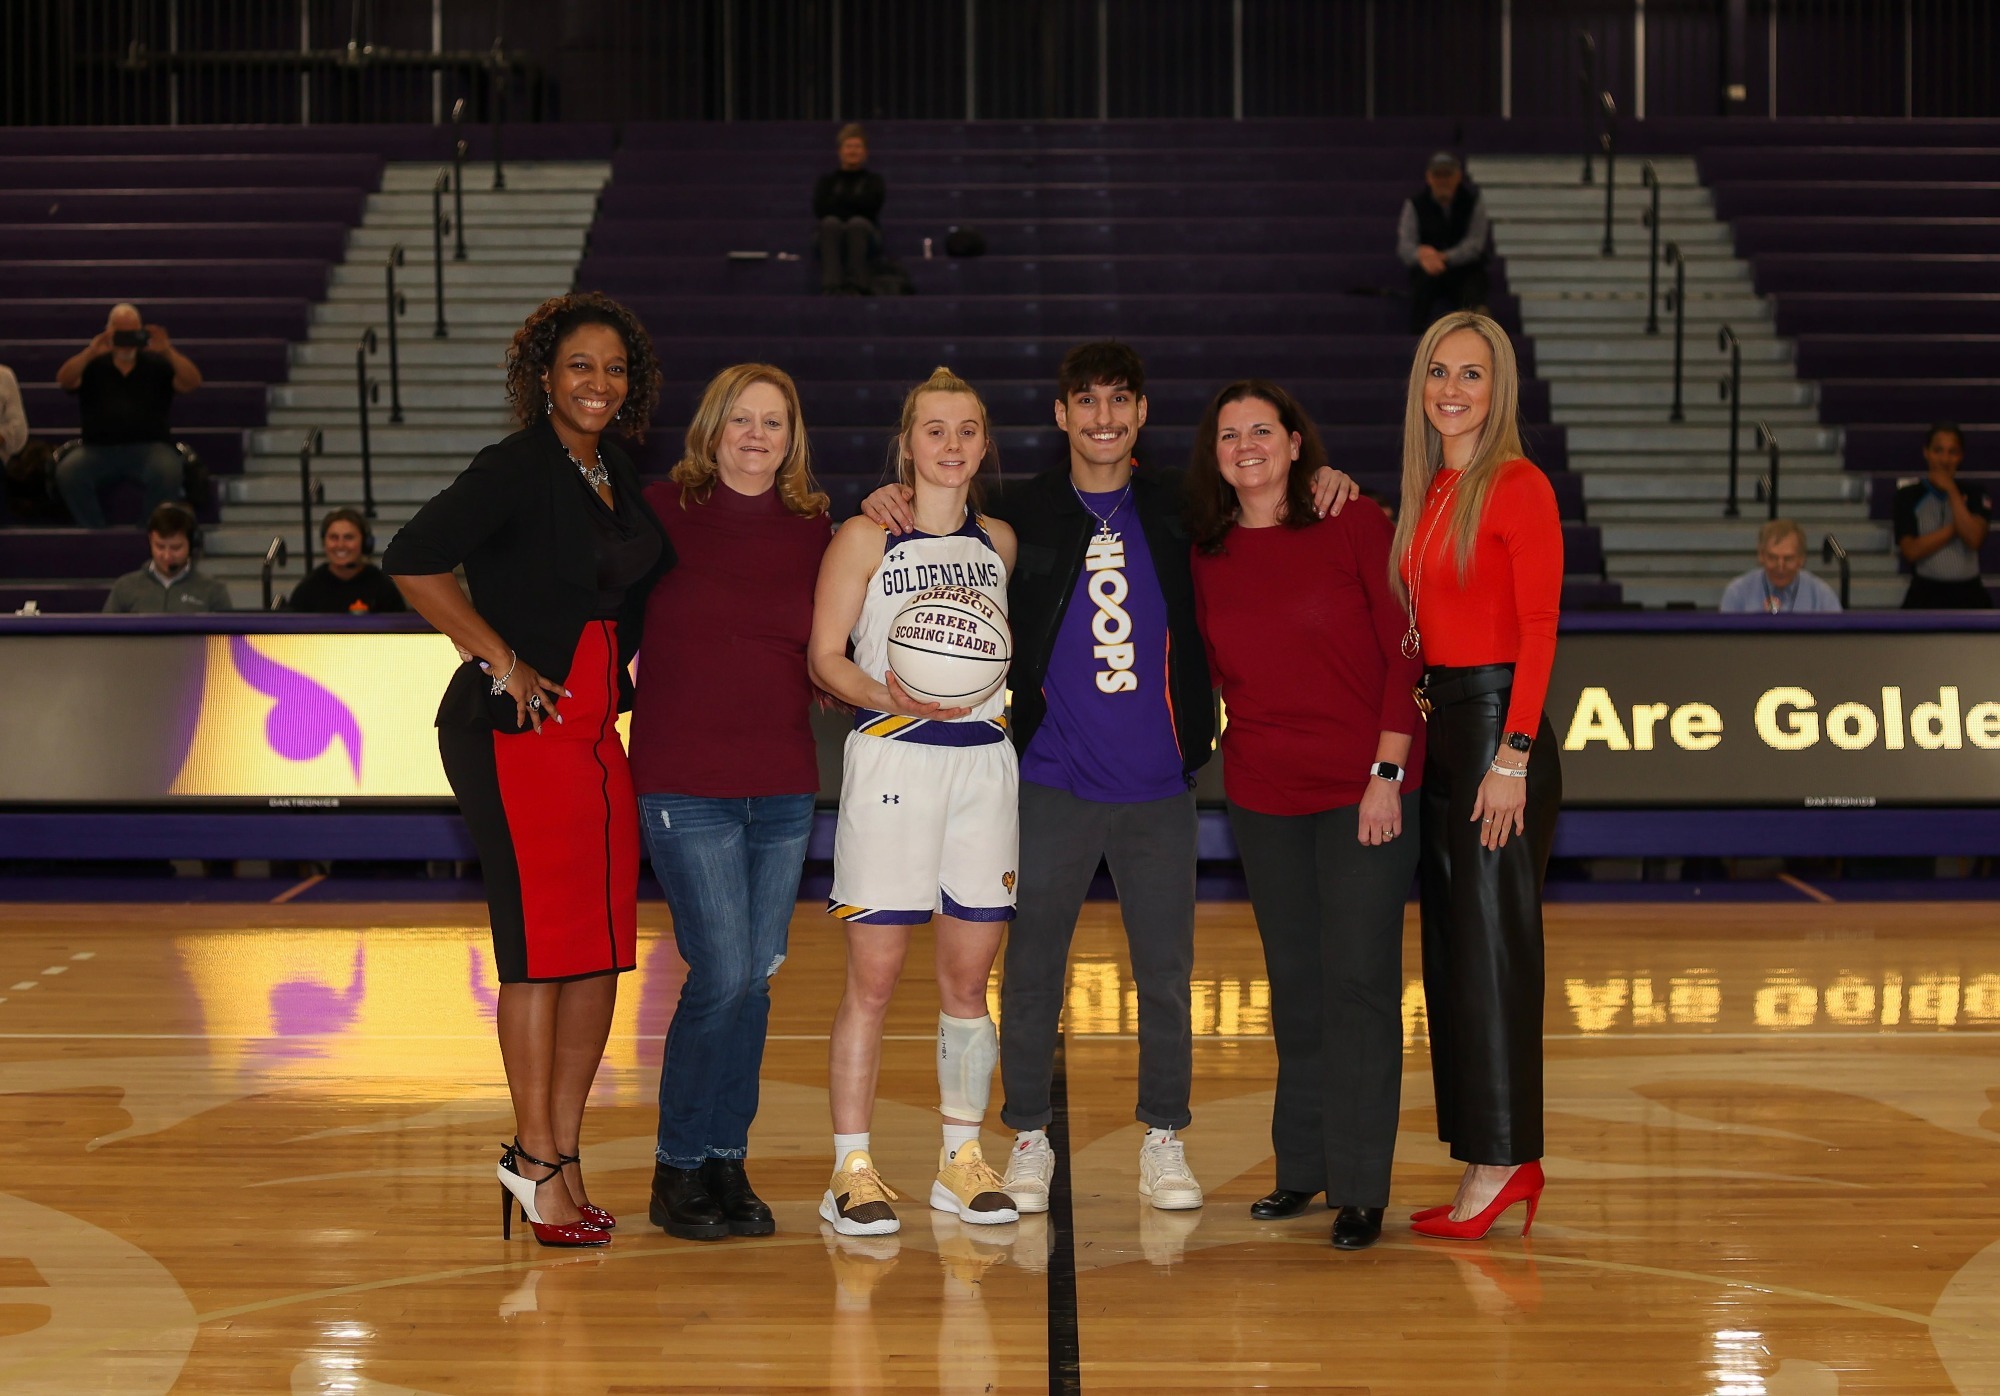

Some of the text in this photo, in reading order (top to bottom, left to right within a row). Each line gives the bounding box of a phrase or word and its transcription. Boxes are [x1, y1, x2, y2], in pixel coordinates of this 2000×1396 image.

[883, 562, 998, 596] GOLDENRAMS
[933, 585, 981, 600] LEAH
[912, 590, 995, 619] JOHNSON
[1085, 540, 1138, 694] HOOPS
[914, 612, 978, 634] CAREER
[895, 626, 996, 655] SCORING LEADER
[1563, 685, 2000, 750] Are Golde
